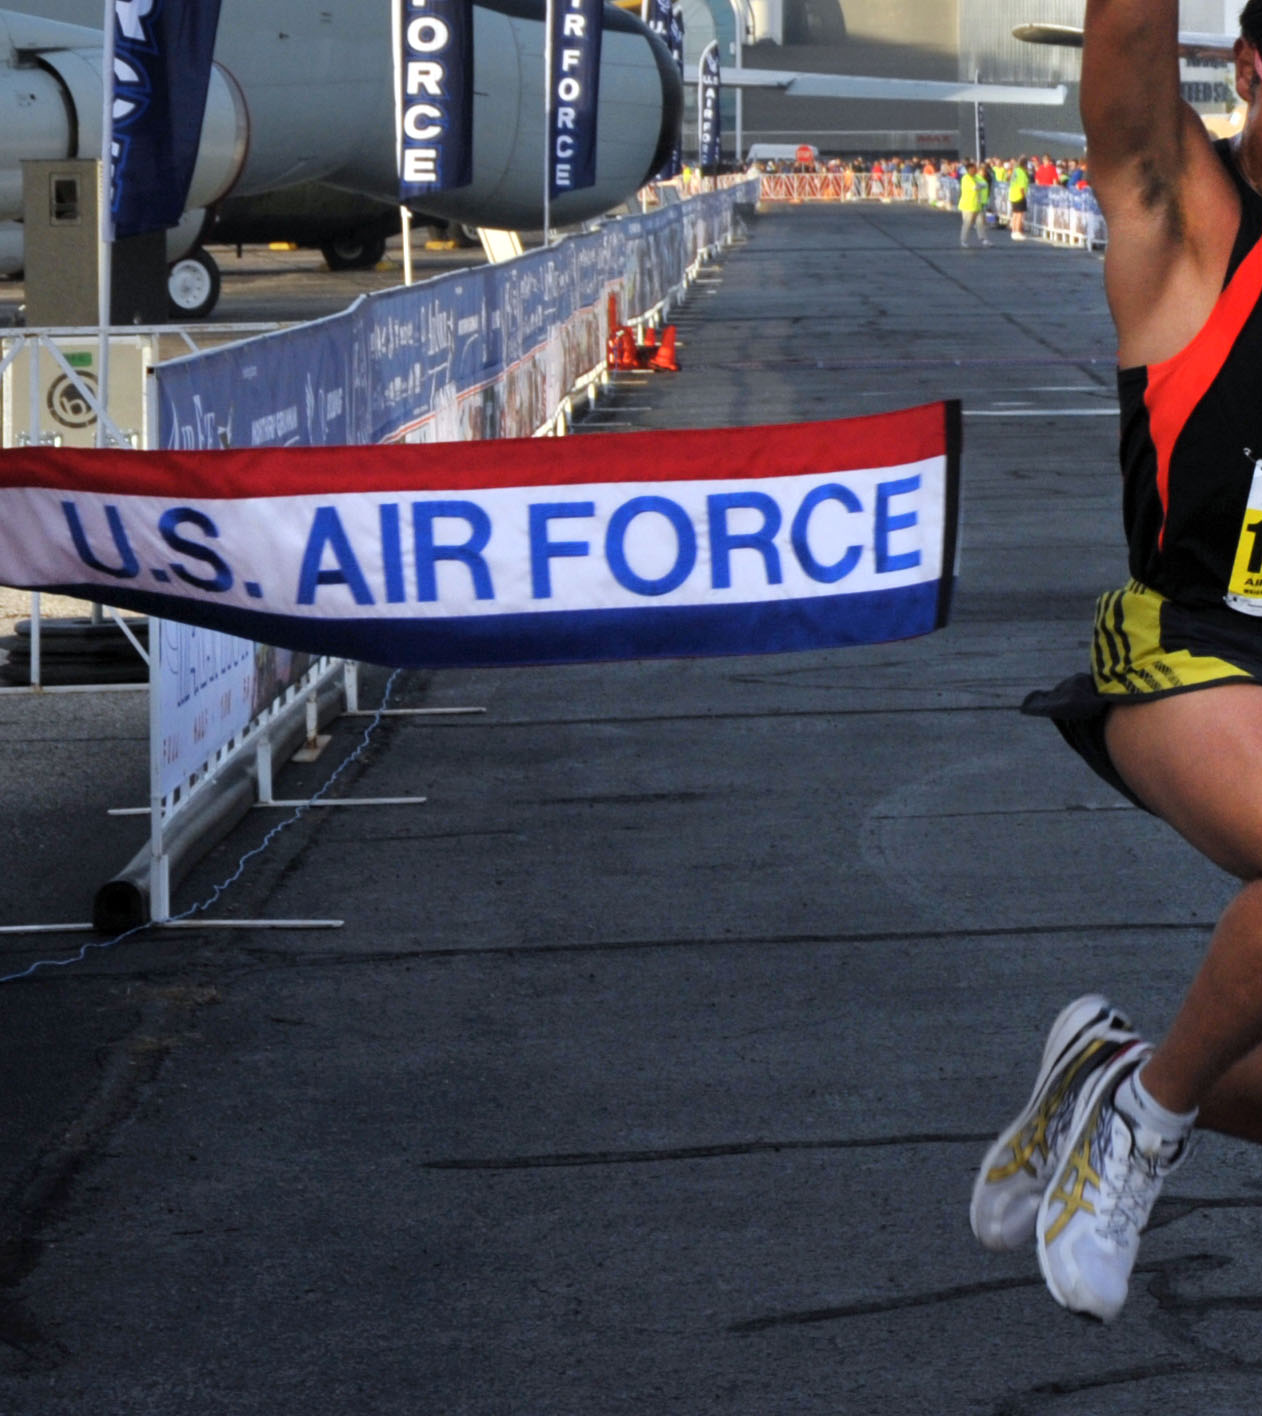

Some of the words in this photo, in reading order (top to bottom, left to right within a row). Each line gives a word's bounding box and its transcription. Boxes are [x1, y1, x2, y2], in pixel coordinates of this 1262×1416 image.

[555, 49, 580, 186] FORCE
[705, 87, 716, 120] AIR
[60, 499, 262, 600] U.S.
[296, 499, 496, 606] AIR
[528, 474, 923, 600] FORCE
